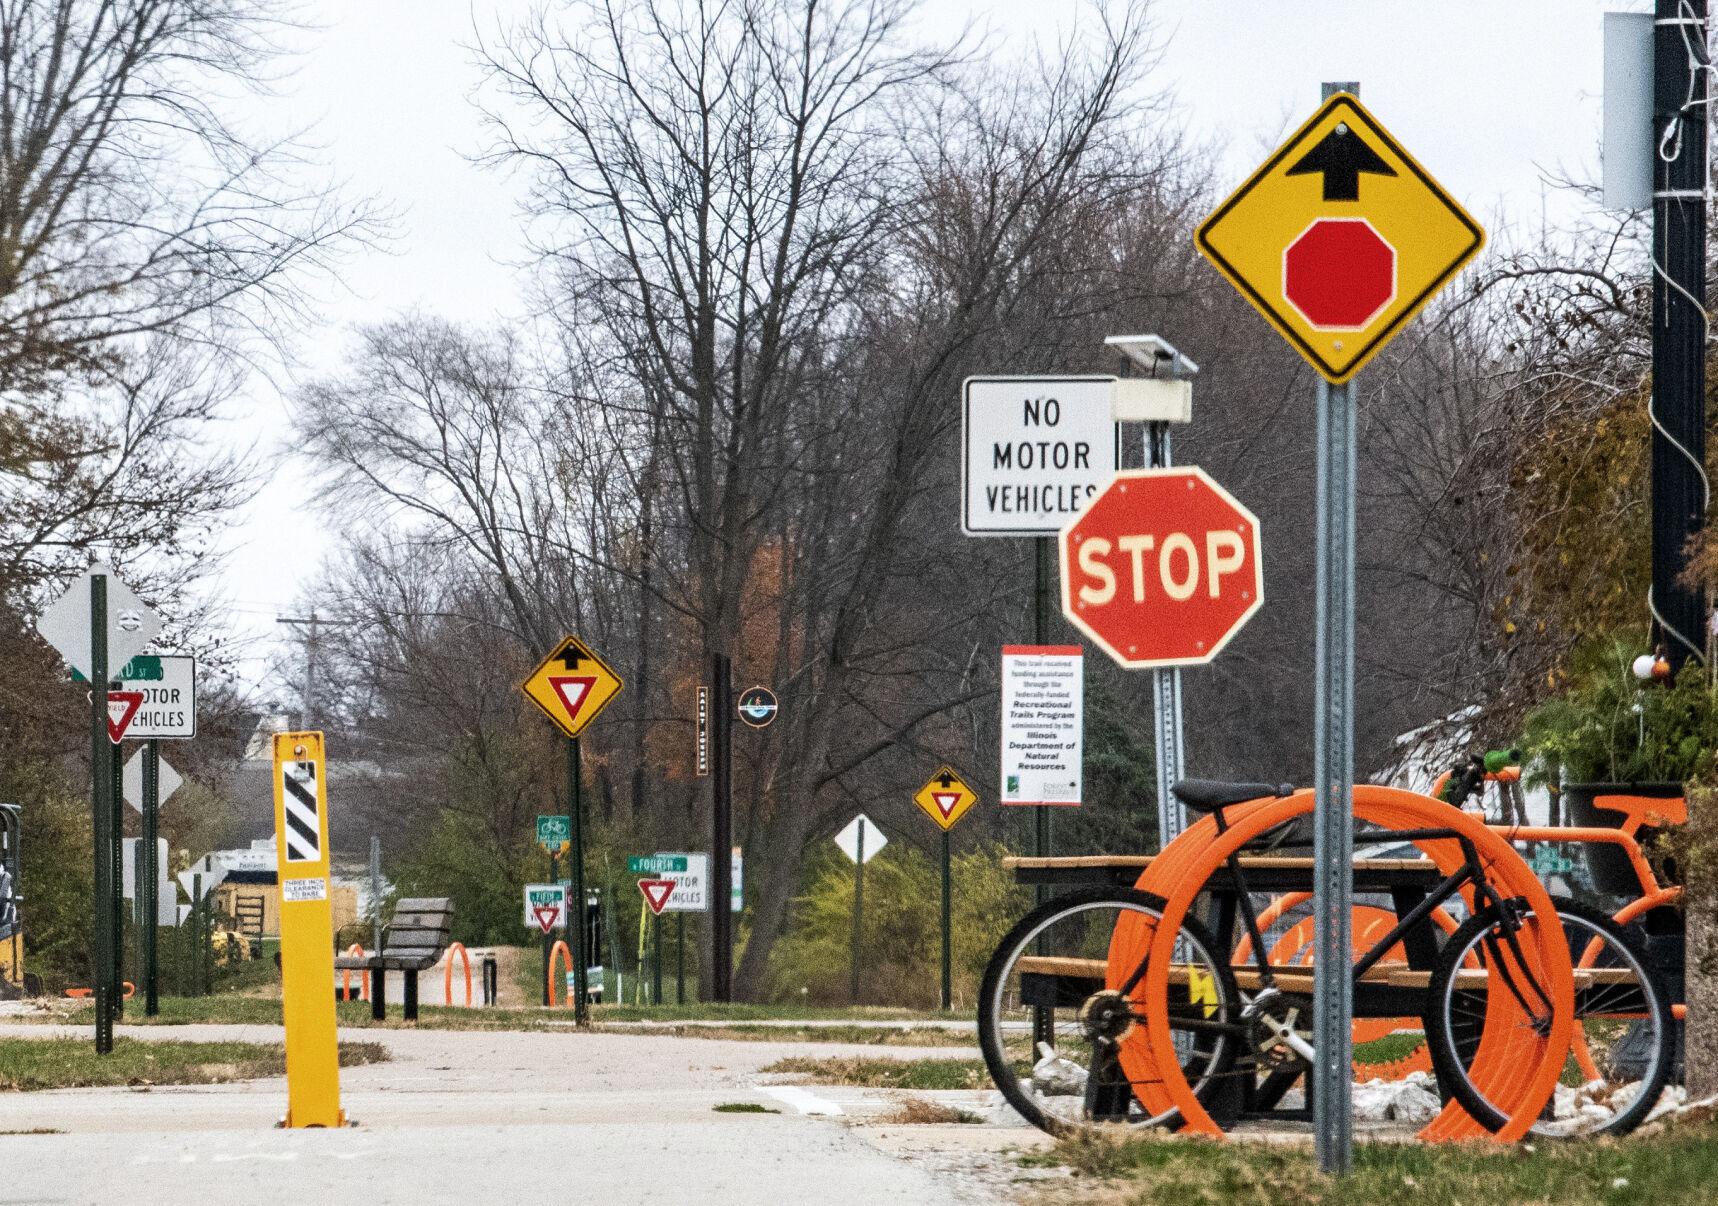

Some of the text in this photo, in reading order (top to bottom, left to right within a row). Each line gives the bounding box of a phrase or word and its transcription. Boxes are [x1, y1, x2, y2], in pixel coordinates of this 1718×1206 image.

[1024, 398, 1060, 427] NO
[993, 441, 1090, 470] MOTOR
[1078, 530, 1245, 604] STOP
[128, 689, 180, 704] OTOR
[1013, 700, 1072, 708] Recreational
[132, 711, 184, 727] EHICLES
[1037, 711, 1075, 720] Program
[1009, 742, 1063, 750] Department
[1026, 752, 1059, 760] Natural
[641, 859, 673, 871] FOURTH
[671, 892, 700, 903] HICLES
